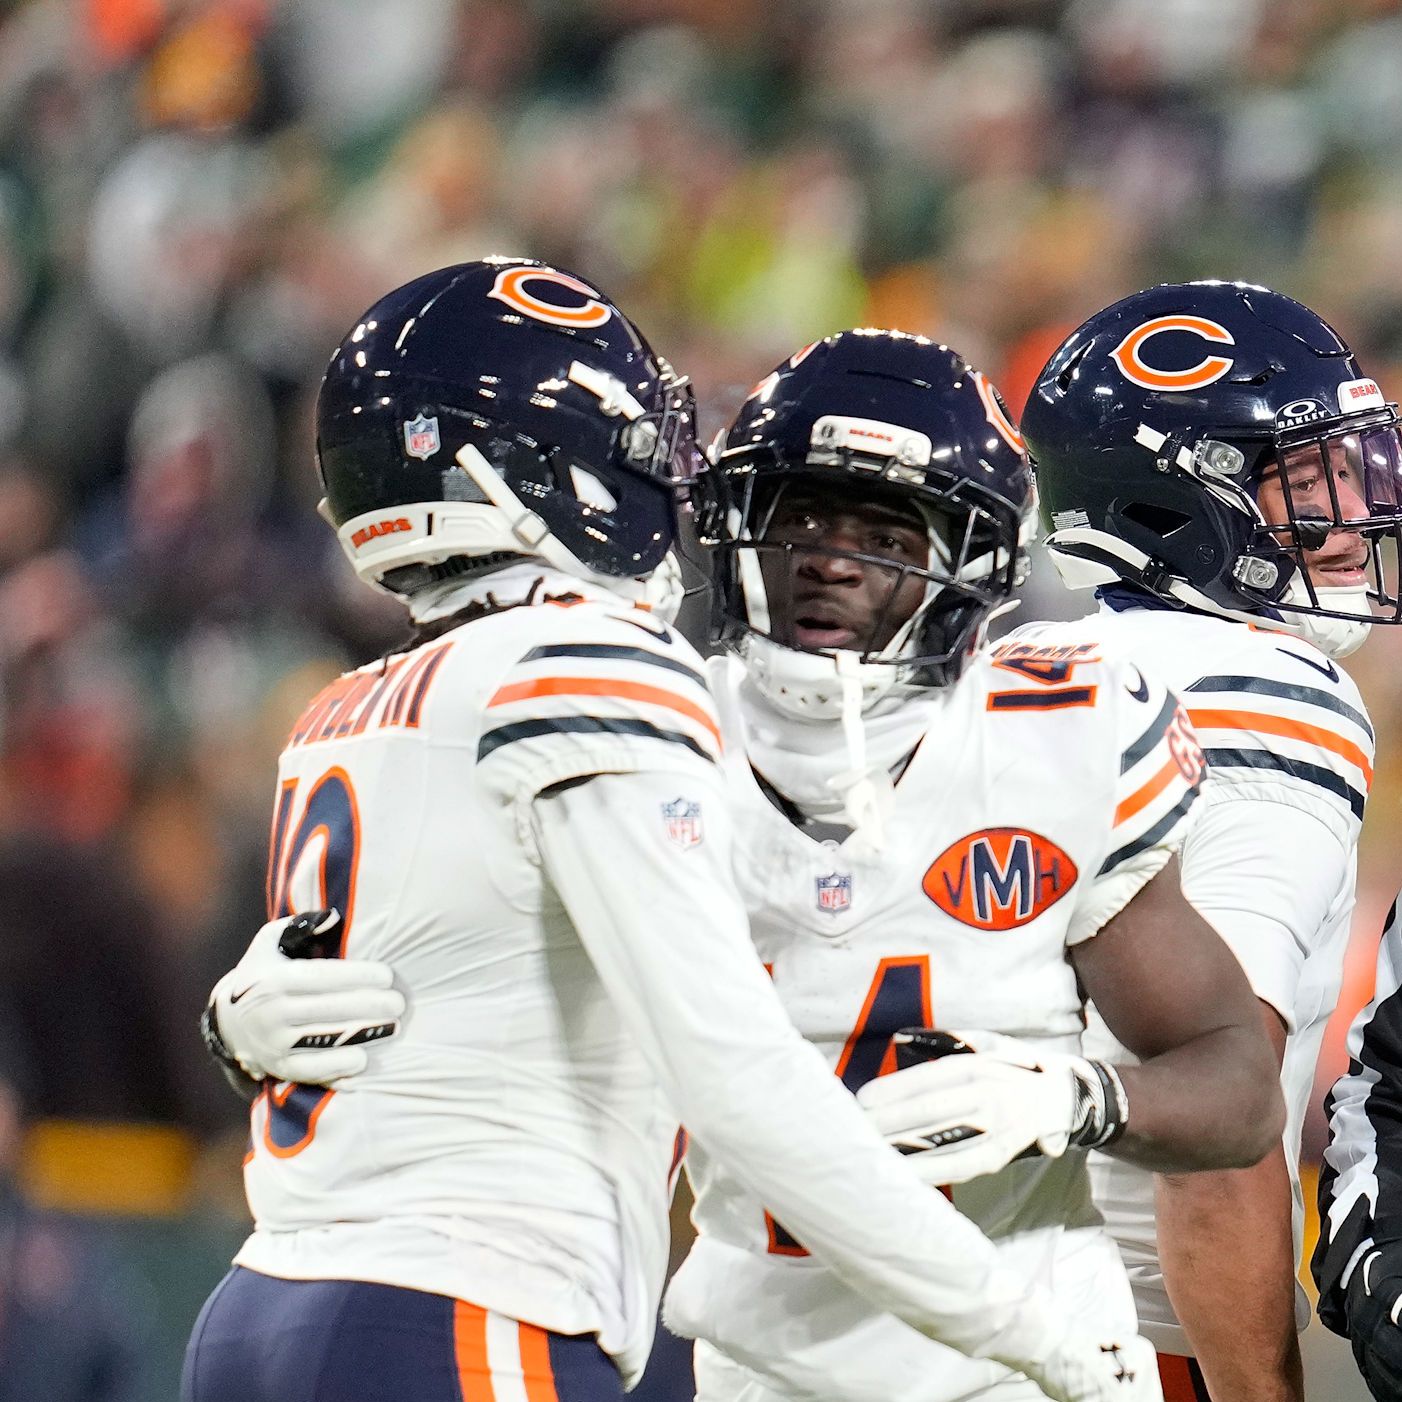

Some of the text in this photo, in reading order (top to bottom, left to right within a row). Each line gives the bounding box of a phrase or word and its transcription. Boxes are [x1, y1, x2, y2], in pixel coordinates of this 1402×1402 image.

[486, 266, 612, 329] C
[1110, 315, 1236, 391] C
[1278, 410, 1328, 428] OAKLEY
[668, 820, 700, 843] NFL
[820, 889, 849, 908] NFL
